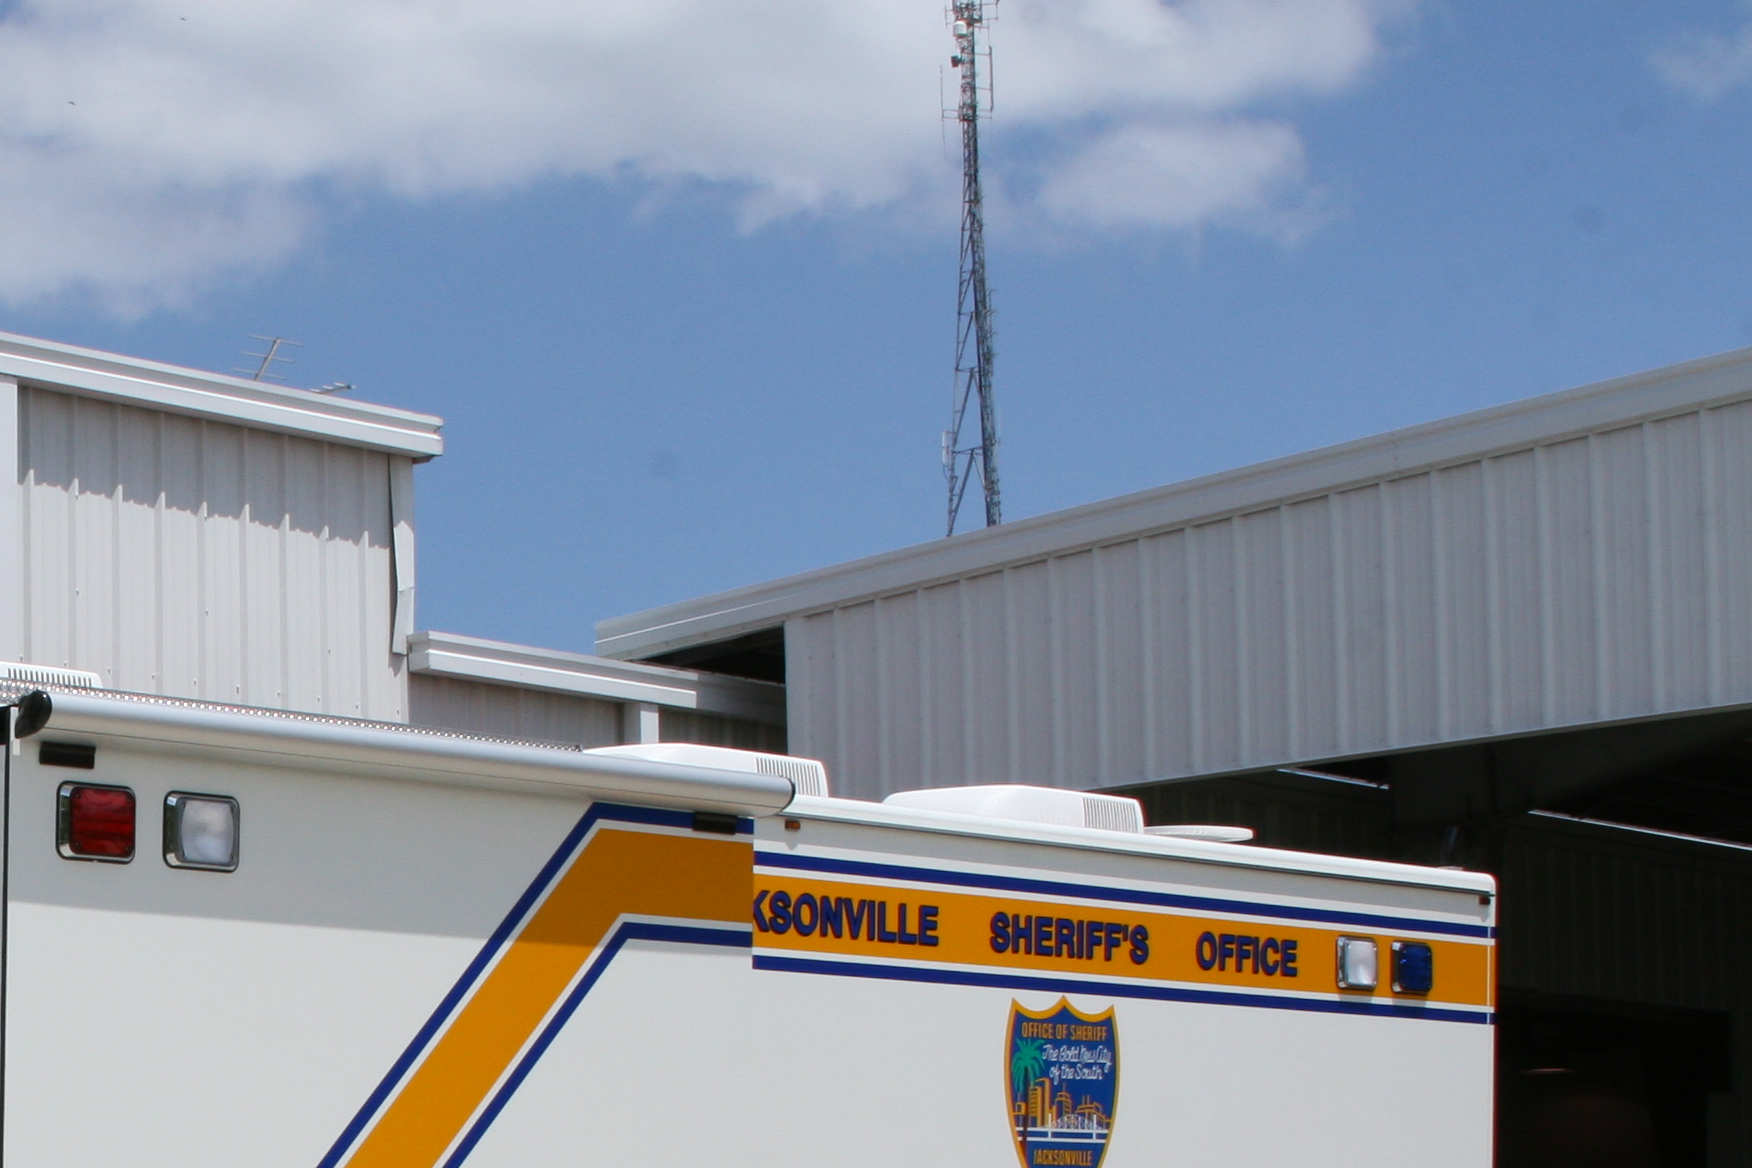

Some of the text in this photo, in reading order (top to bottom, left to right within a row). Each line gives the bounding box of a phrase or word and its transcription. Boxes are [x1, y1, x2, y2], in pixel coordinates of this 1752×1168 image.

[989, 910, 1149, 965] SHERIFF'S
[1195, 930, 1299, 977] OFFICE
[1021, 1022, 1108, 1042] OFFICE OF SHERIFF
[1042, 1044, 1059, 1061] The
[1049, 1063, 1103, 1086] of the South
[1033, 1149, 1093, 1167] JACKSONVILLE
